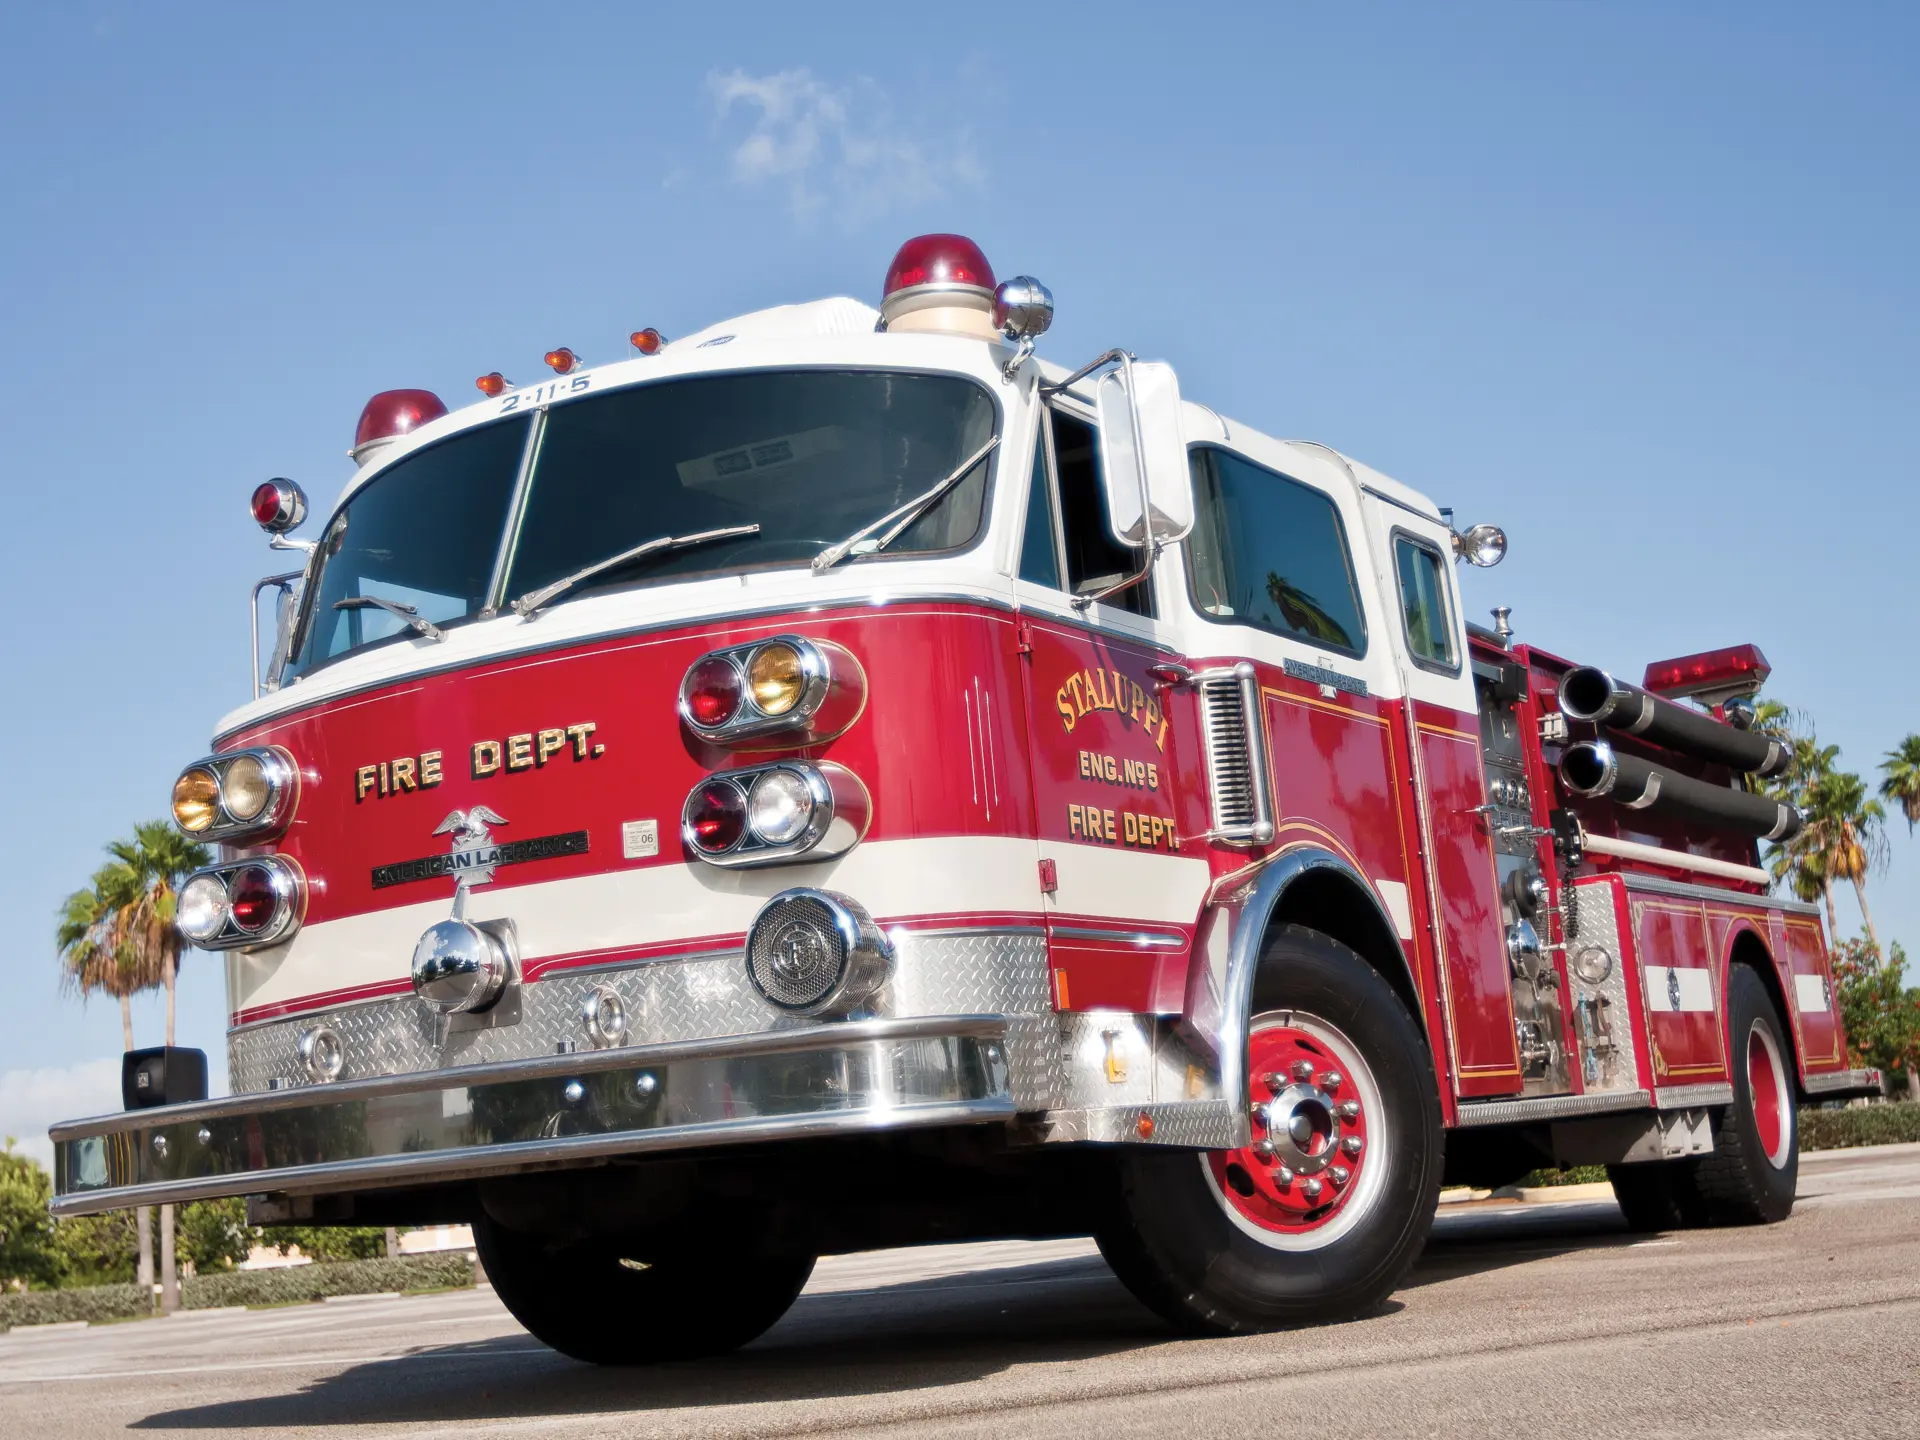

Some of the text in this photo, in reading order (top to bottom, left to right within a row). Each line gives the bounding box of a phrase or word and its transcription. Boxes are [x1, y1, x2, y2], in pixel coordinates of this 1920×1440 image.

[1056, 668, 1168, 752] STALUPPI
[357, 722, 605, 802] FIRE DEPT.
[641, 834, 654, 844] 06
[1068, 803, 1180, 852] FIRE DEPT.
[377, 834, 588, 885] AMERICAN LAFRANCE
